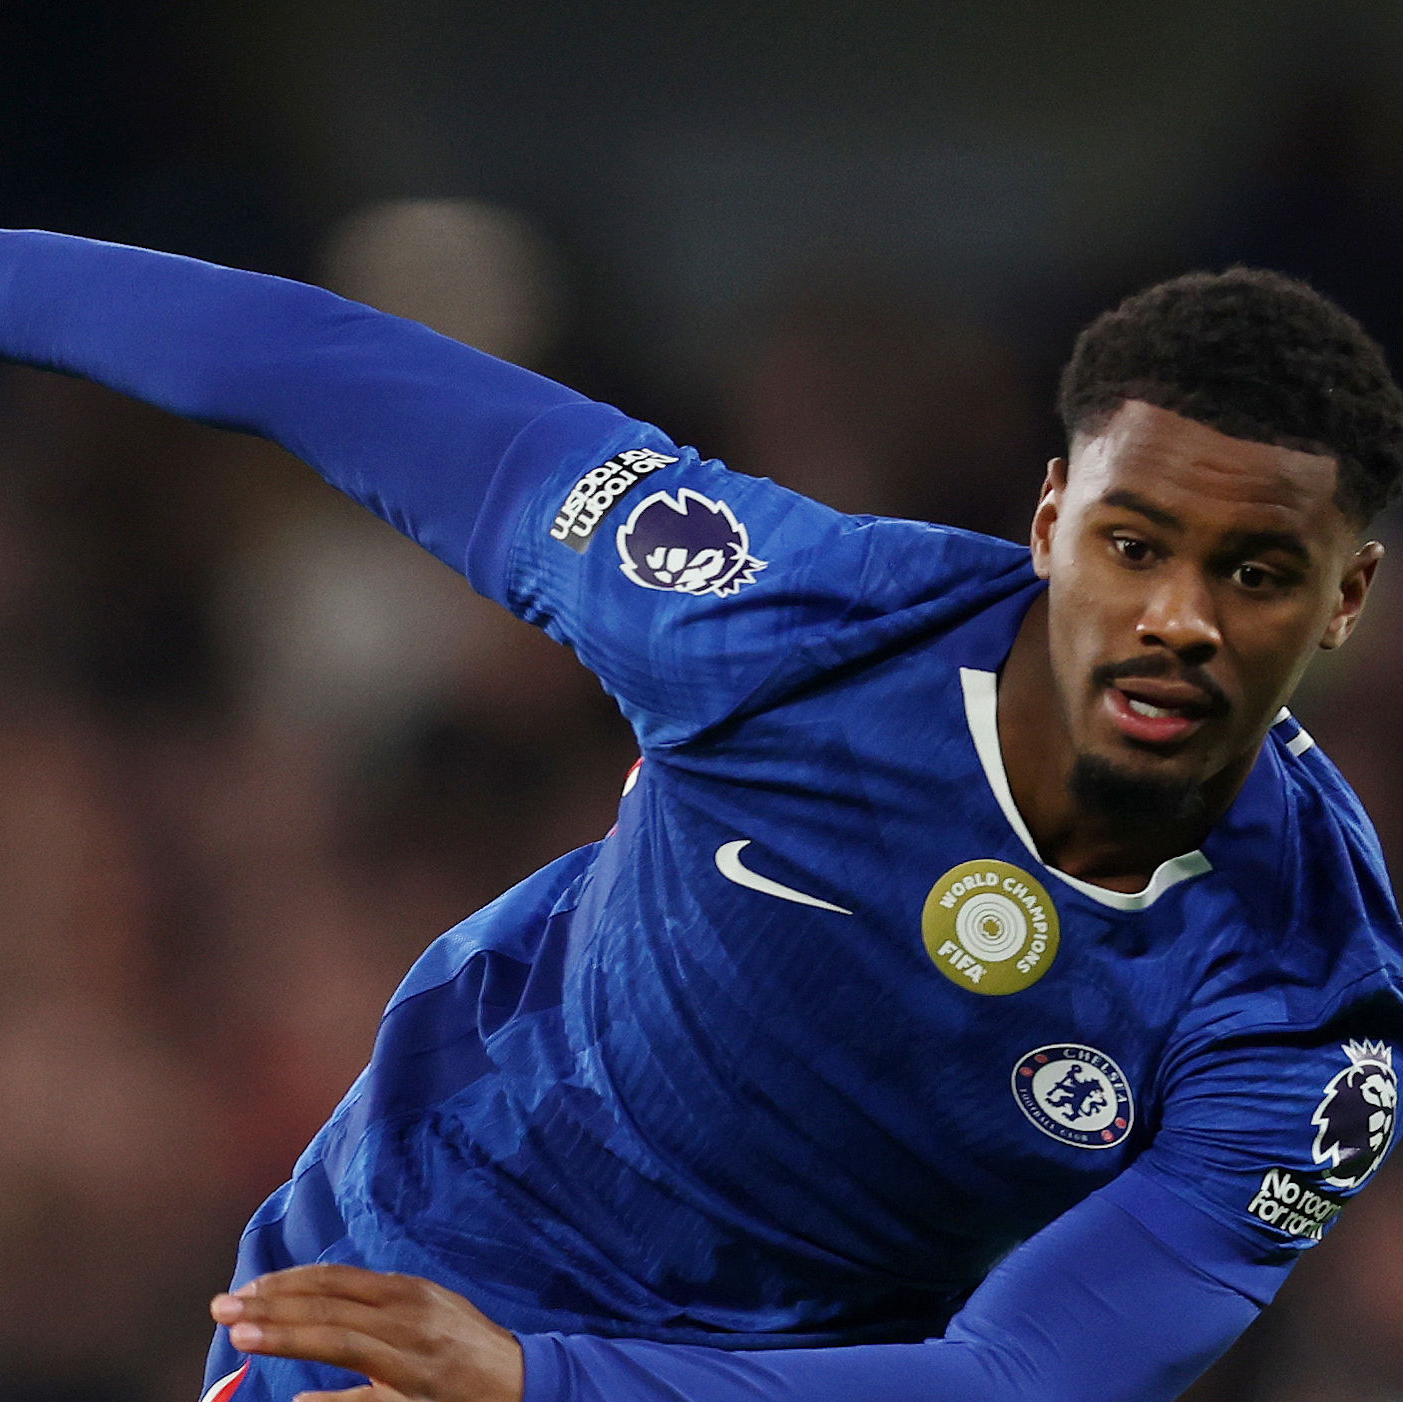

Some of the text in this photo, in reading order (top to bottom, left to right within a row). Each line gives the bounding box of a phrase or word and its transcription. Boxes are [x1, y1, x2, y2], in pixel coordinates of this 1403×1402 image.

[550, 461, 623, 540] racism
[571, 455, 679, 538] No room
[939, 872, 1048, 974] WORLD CHAMPIONS
[937, 939, 985, 984] FIFA
[1063, 1049, 1128, 1103] CHELSEA
[1261, 1168, 1300, 1204] No
